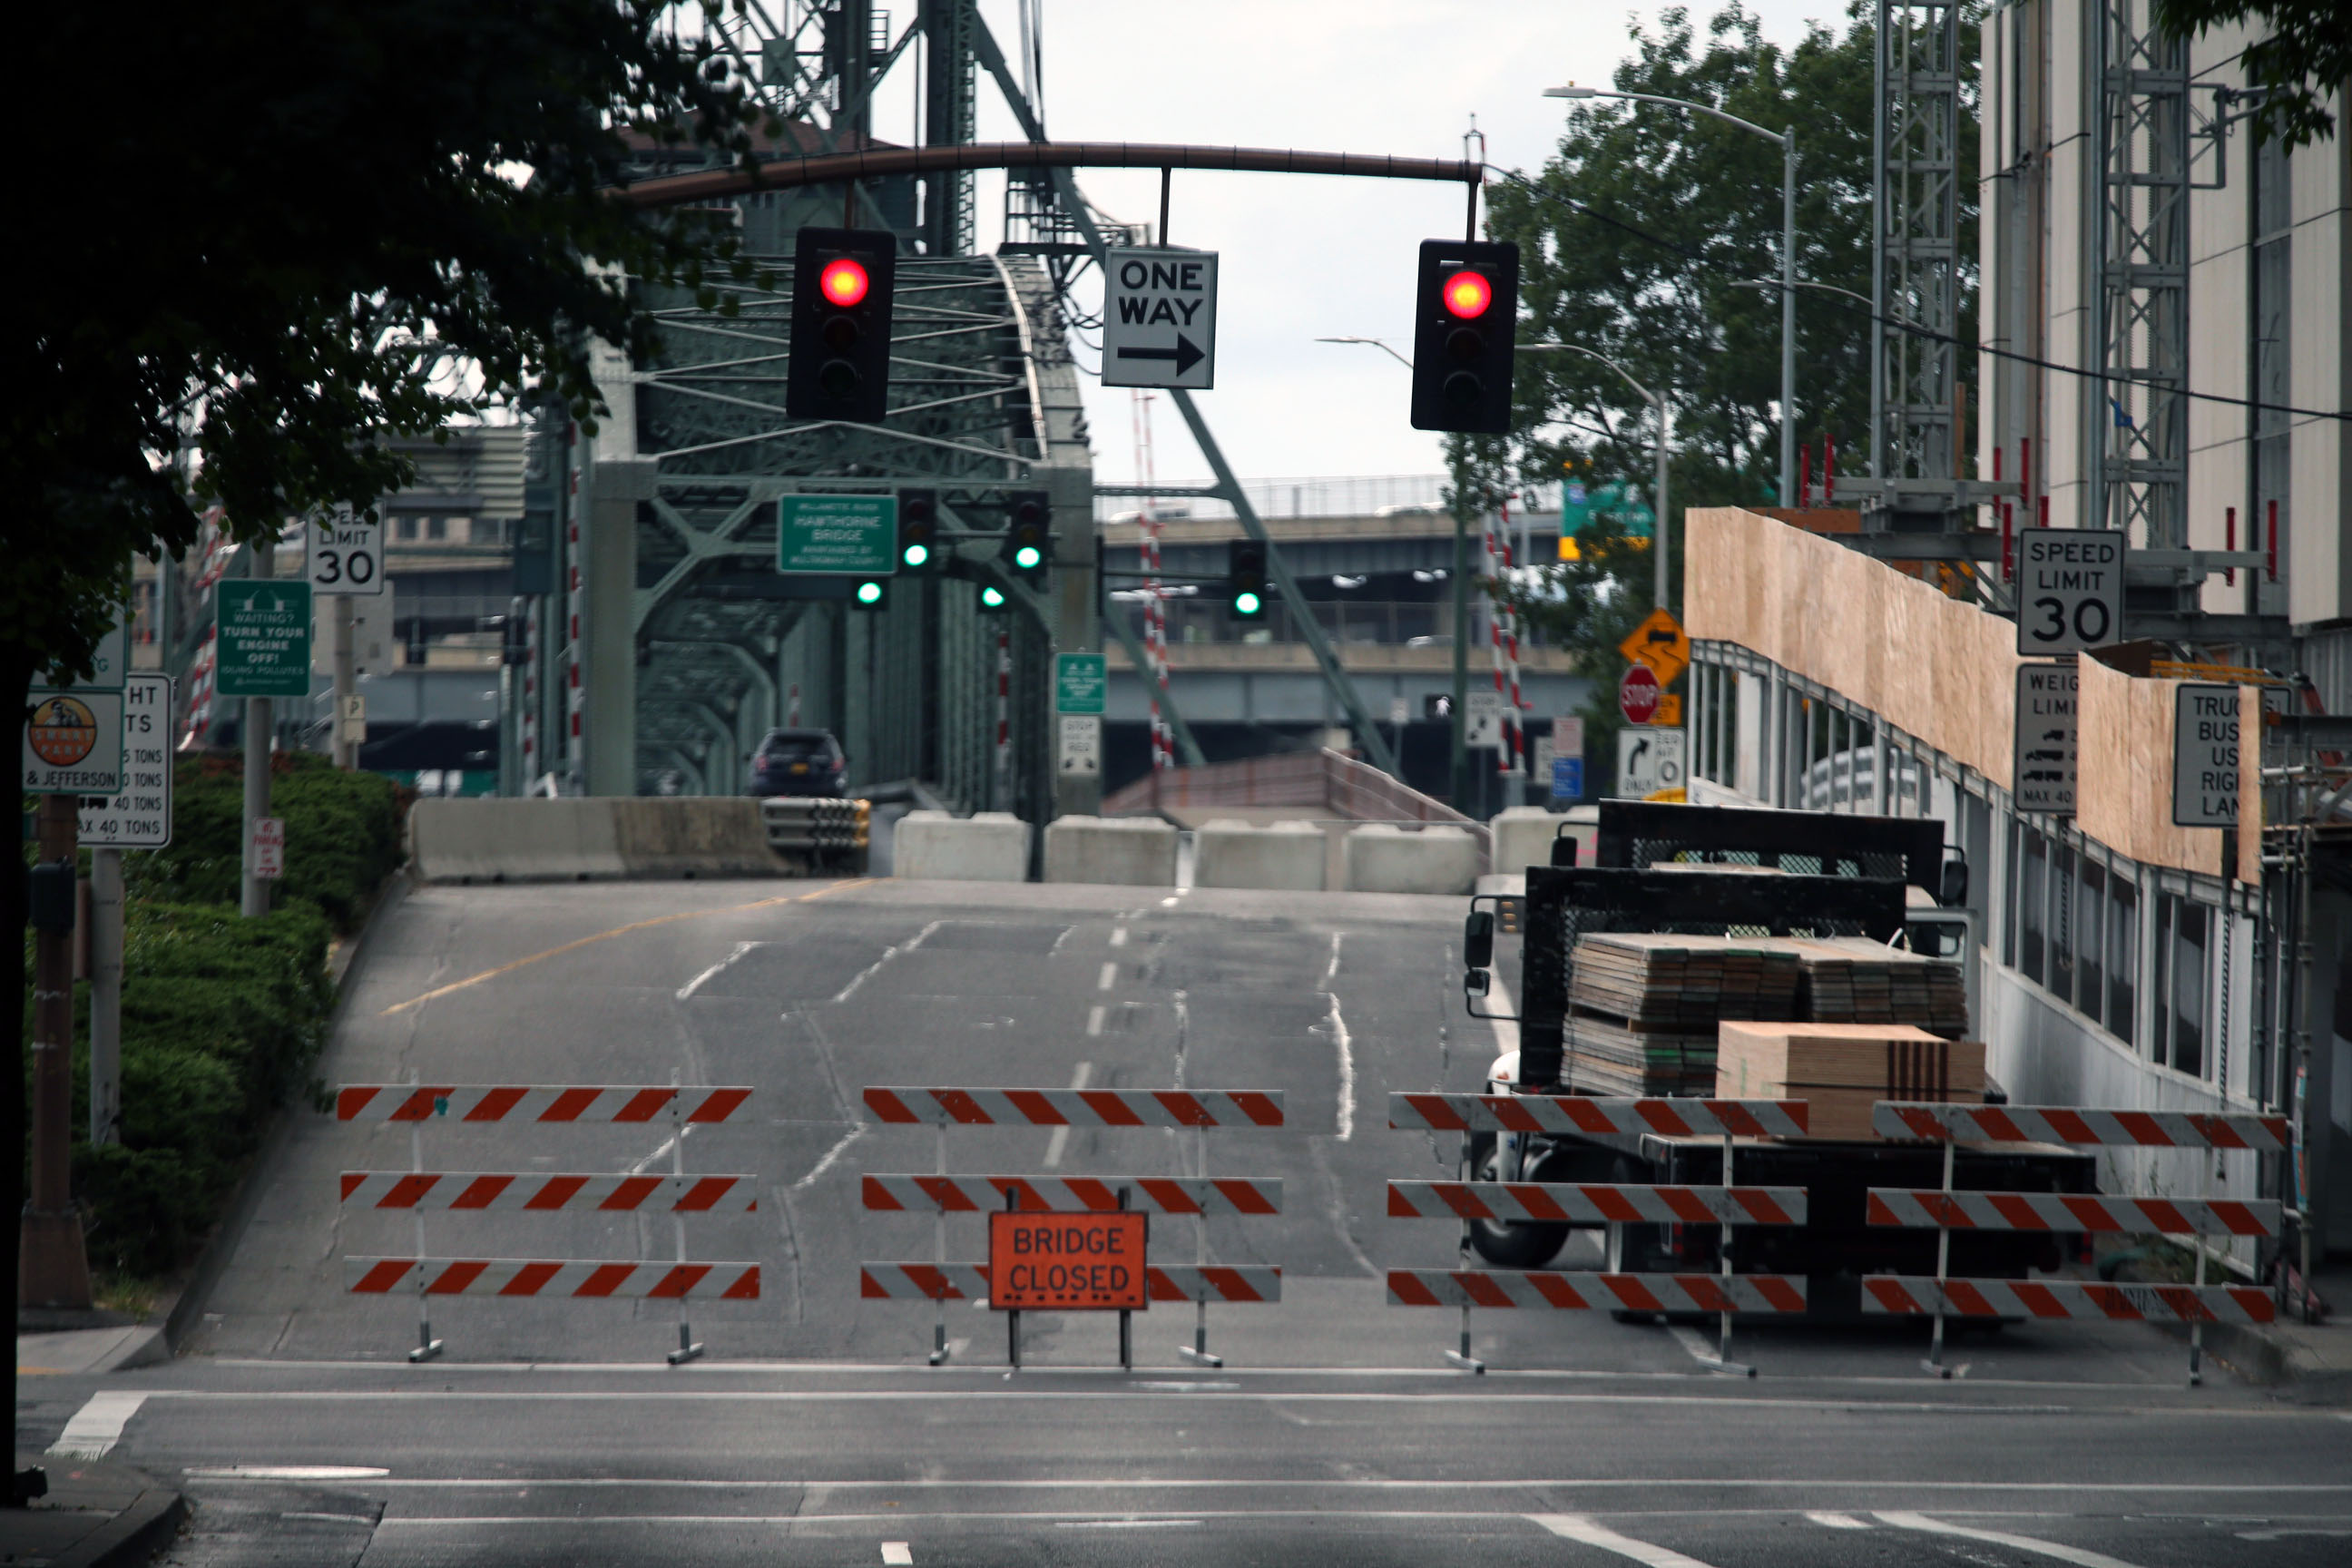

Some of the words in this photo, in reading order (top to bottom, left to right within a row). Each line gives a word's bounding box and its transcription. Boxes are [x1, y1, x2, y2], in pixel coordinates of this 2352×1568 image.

[1120, 260, 1203, 291] ONE
[1118, 296, 1204, 327] WAY
[812, 529, 864, 543] BRIDGE
[2030, 542, 2114, 564] SPEED
[316, 550, 374, 585] 30
[2038, 569, 2104, 591] LIMIT
[2032, 596, 2111, 643] 30
[223, 626, 261, 638] TURN
[266, 626, 306, 638] YOUR
[237, 639, 289, 651] ENGINE
[247, 652, 279, 664] OFF!
[2031, 674, 2079, 691] WEIG
[1622, 683, 1658, 707] STOP
[2034, 698, 2077, 715] LIMI
[34, 729, 92, 741] SMART
[2199, 722, 2239, 741] BUS
[40, 744, 86, 756] PARK
[135, 750, 162, 764] TONS
[2212, 748, 2239, 767] US
[26, 771, 38, 786] &
[43, 771, 117, 787] JEFFERSON
[135, 773, 162, 788] TONS
[1624, 778, 1652, 791] ONLY
[113, 797, 130, 810] 40
[135, 797, 162, 811] TONS
[2024, 790, 2050, 803] MAX
[2055, 791, 2073, 803] 40
[2203, 797, 2239, 818] LAN
[100, 819, 118, 834] 40
[125, 820, 161, 835] TONS
[1014, 1227, 1125, 1254] BRIDGE
[1009, 1264, 1130, 1291] CLOSED
